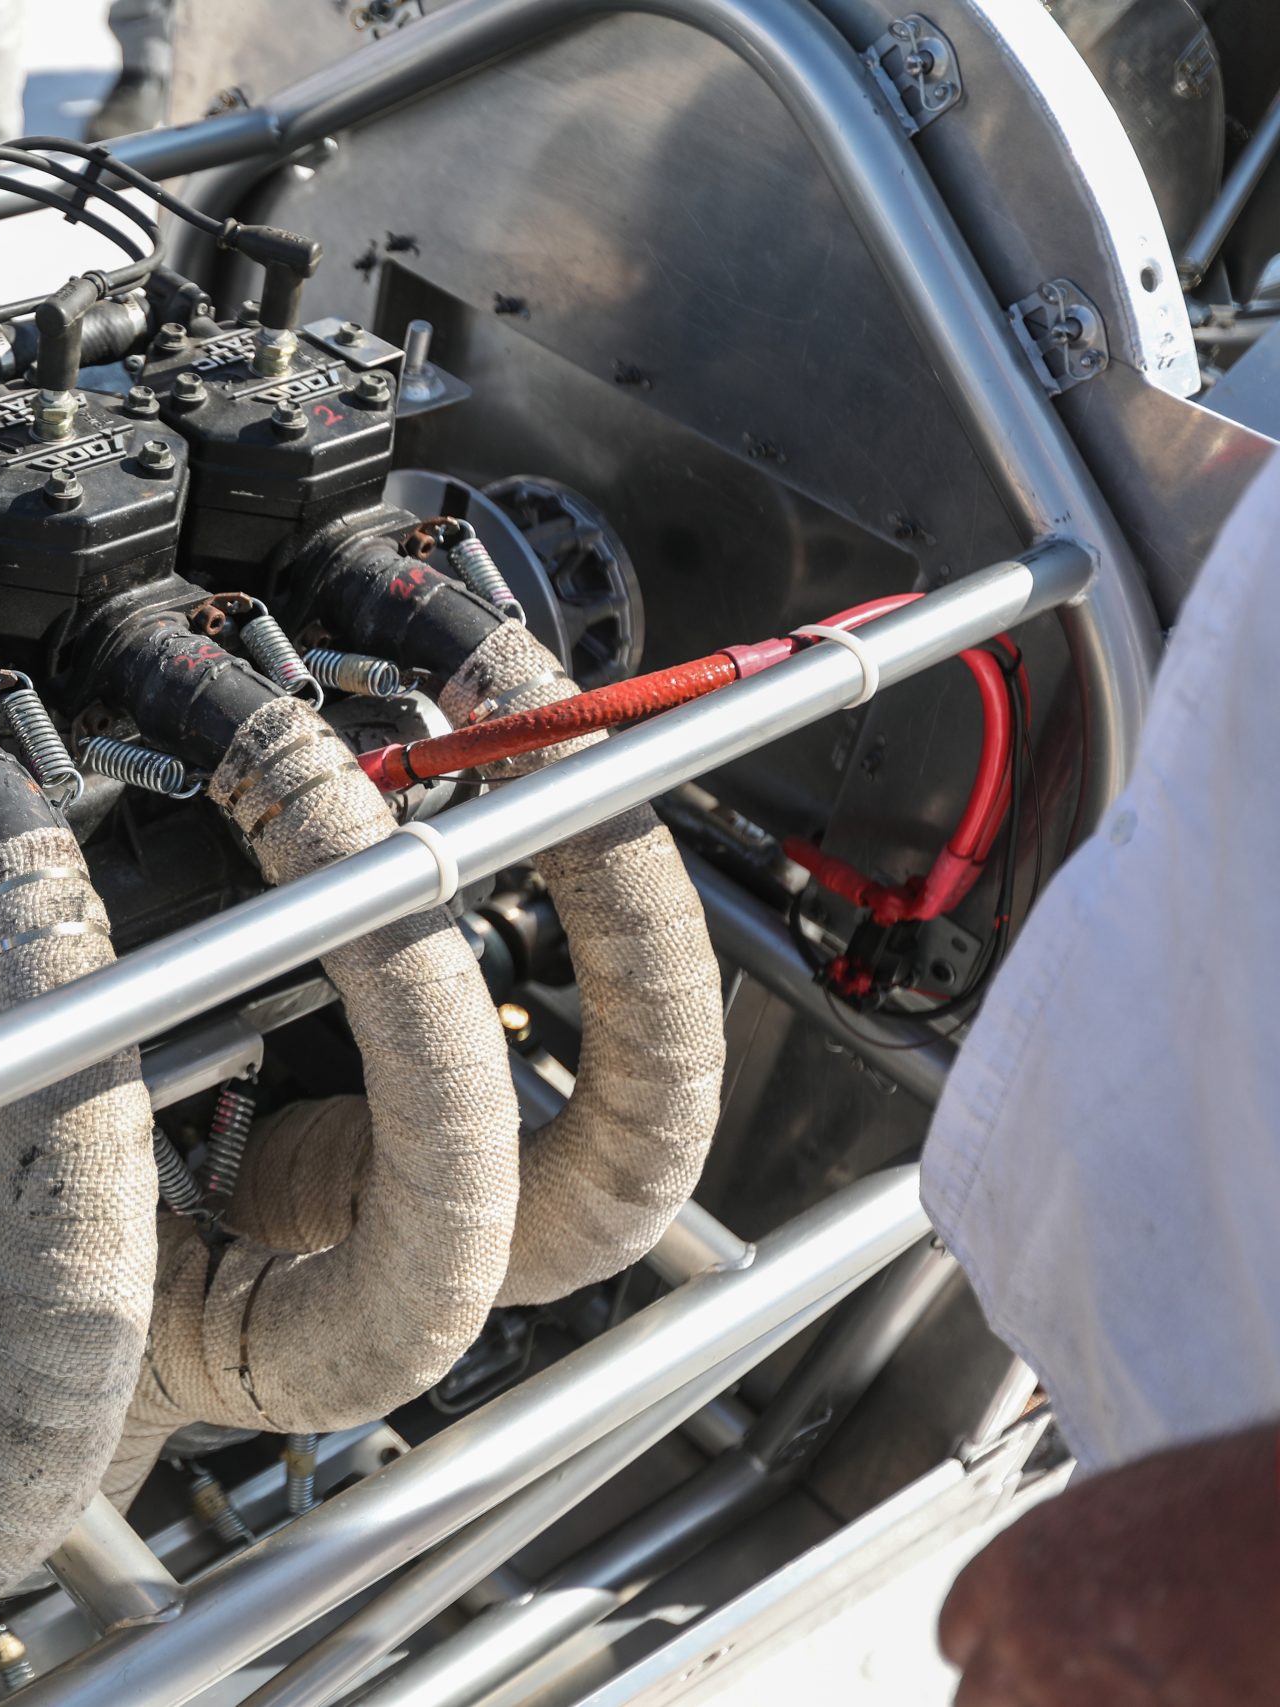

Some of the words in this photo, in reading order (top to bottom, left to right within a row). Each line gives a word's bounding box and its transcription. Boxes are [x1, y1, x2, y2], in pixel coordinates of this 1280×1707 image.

[256, 369, 341, 401] 1000
[313, 405, 344, 427] 2
[31, 434, 124, 469] 1000
